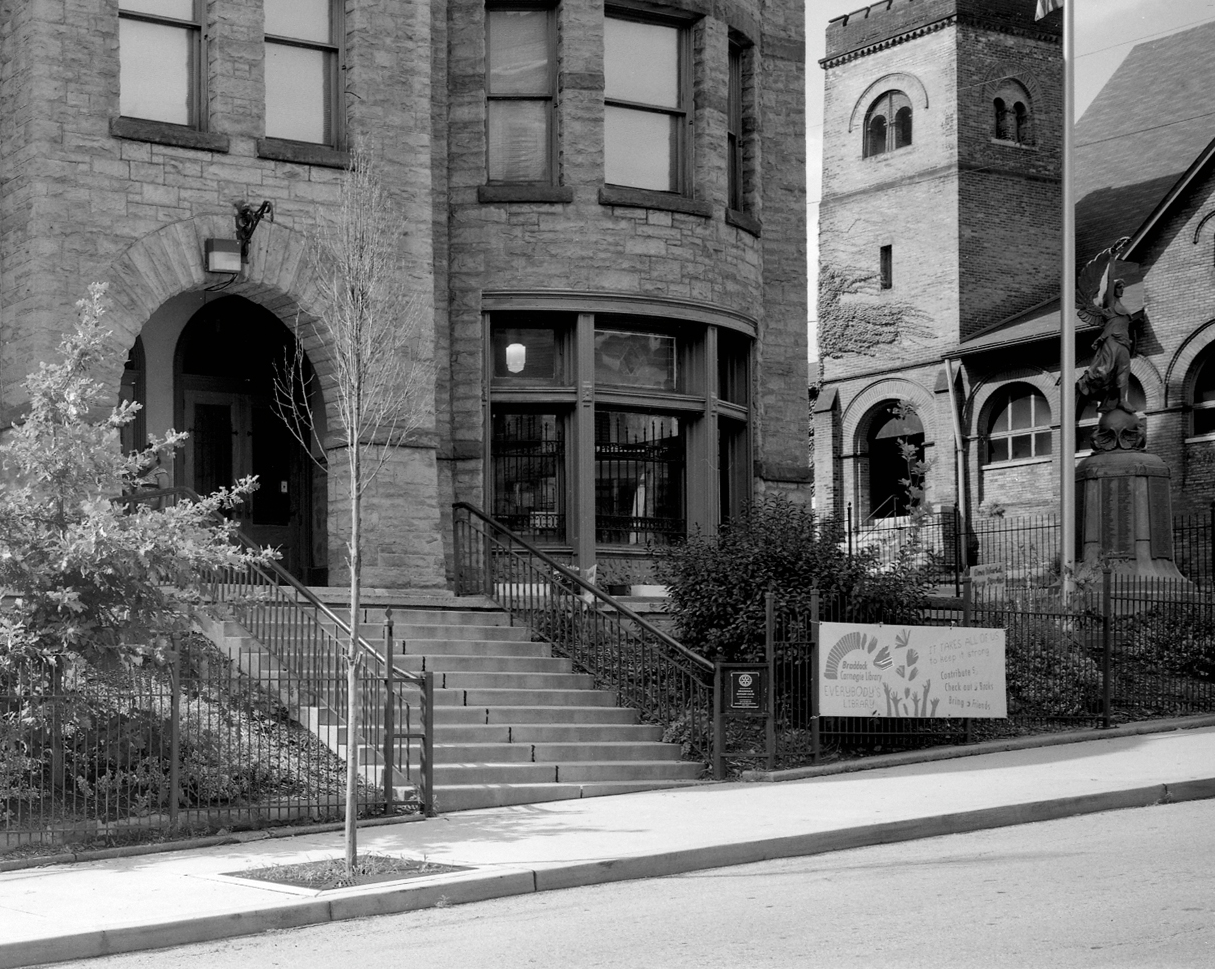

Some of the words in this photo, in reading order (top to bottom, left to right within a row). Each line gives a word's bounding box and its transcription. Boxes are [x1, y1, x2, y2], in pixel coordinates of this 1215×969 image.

[940, 639, 962, 652] TAKES
[965, 635, 978, 646] ALL
[979, 633, 988, 643] OF
[990, 631, 1000, 641] US
[842, 660, 867, 670] Braddock
[840, 670, 864, 683] Carnegie
[865, 671, 882, 683] Library
[940, 668, 971, 680] Contribute
[824, 685, 881, 698] EVERYBODY'S
[945, 682, 961, 692] Check
[963, 684, 973, 692] out
[843, 699, 875, 709] LIBRARY
[948, 695, 965, 708] Bring
